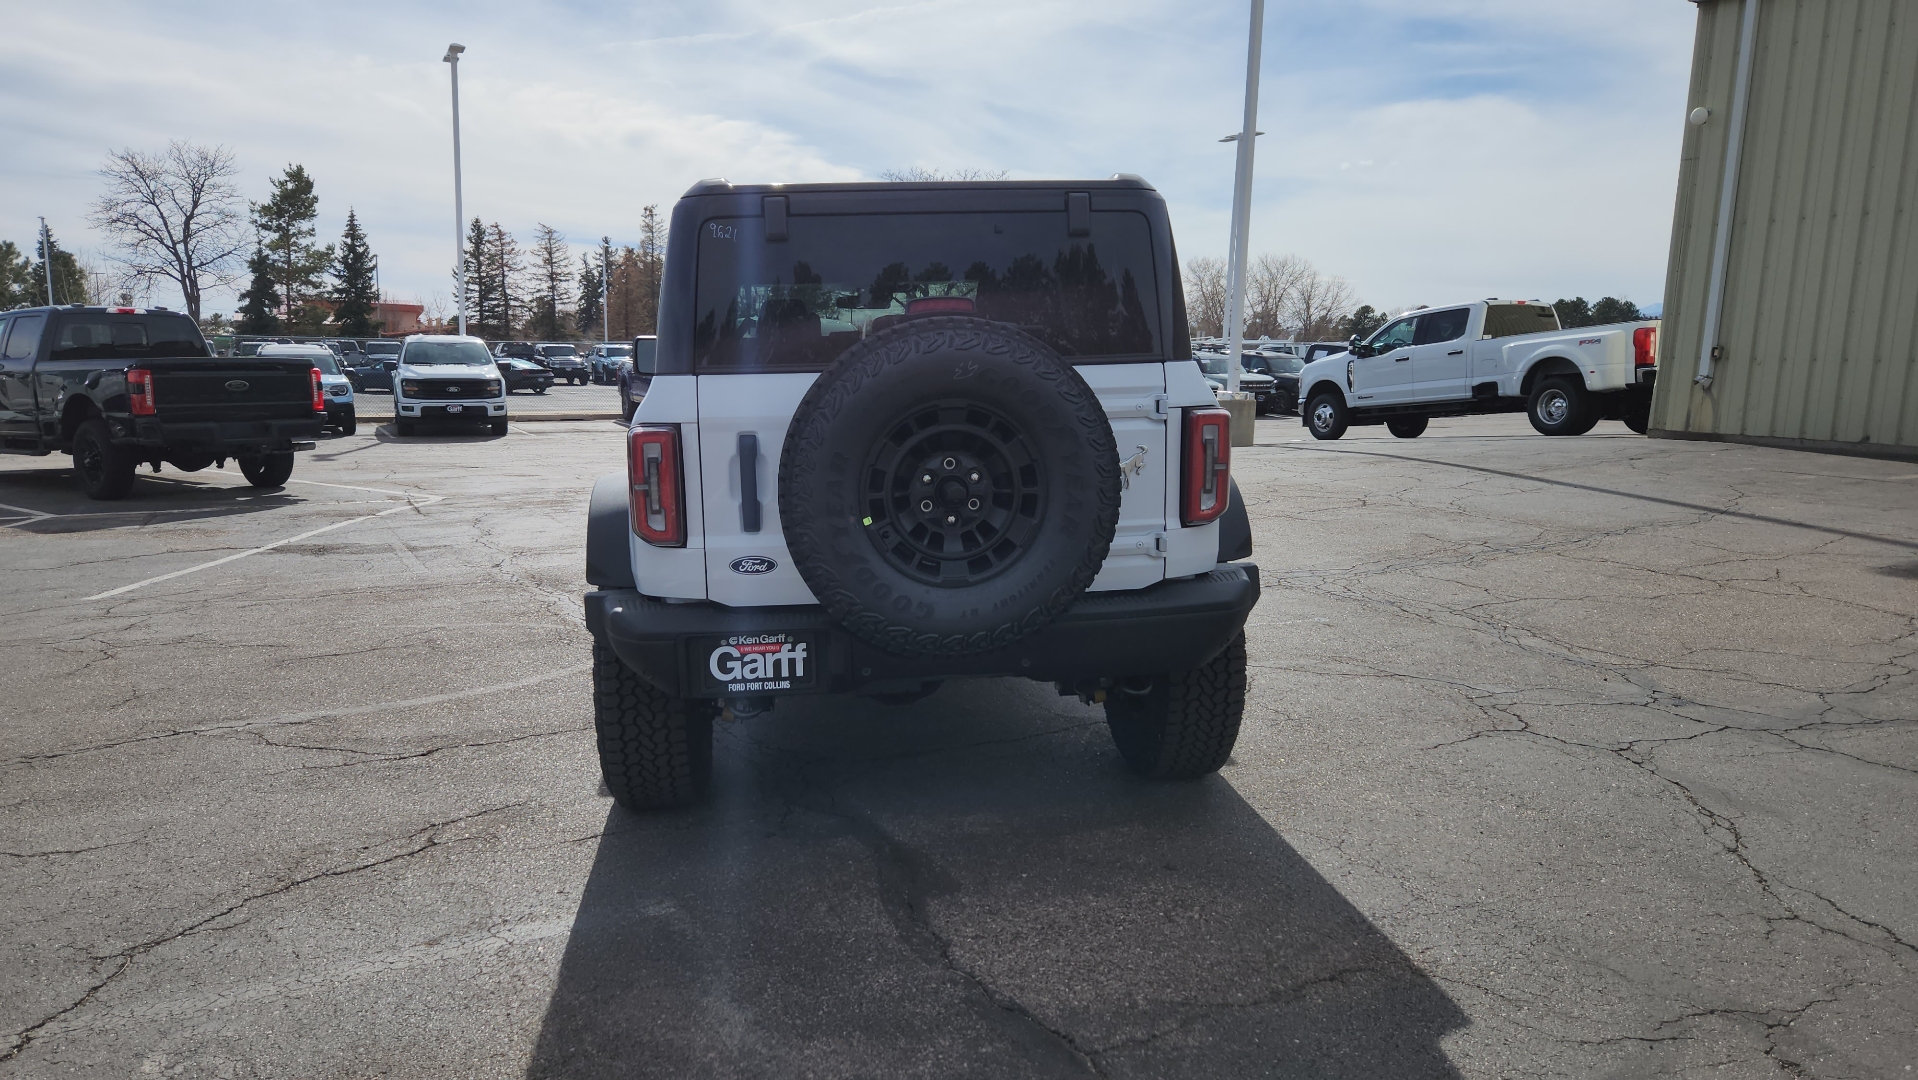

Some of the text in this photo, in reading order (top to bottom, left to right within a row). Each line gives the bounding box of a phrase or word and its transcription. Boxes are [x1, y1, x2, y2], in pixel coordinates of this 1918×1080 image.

[710, 223, 737, 242] 9621
[739, 560, 768, 572] Ford
[739, 634, 786, 645] Ken Garff
[709, 643, 807, 681] Garff
[728, 680, 790, 692] FORD FORT COLLINS
